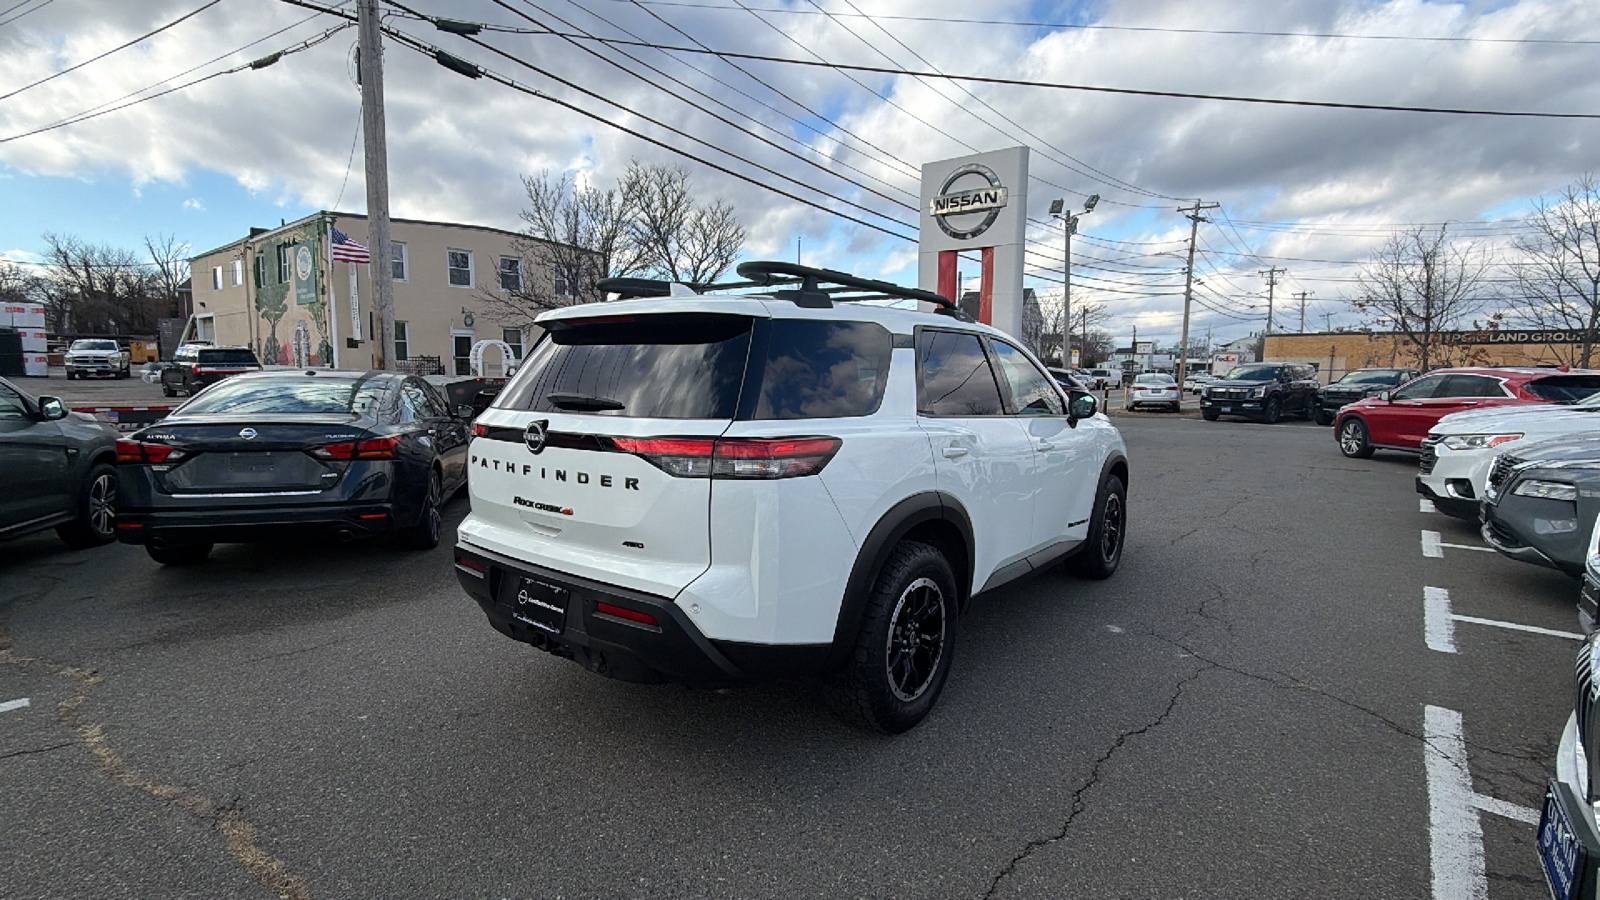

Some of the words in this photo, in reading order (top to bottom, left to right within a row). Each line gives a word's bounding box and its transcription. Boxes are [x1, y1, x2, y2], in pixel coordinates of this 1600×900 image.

[935, 191, 998, 211] NISSAN
[1215, 355, 1236, 363] FedEx
[471, 454, 641, 491] PATHFINDER
[621, 540, 645, 550] 4WD
